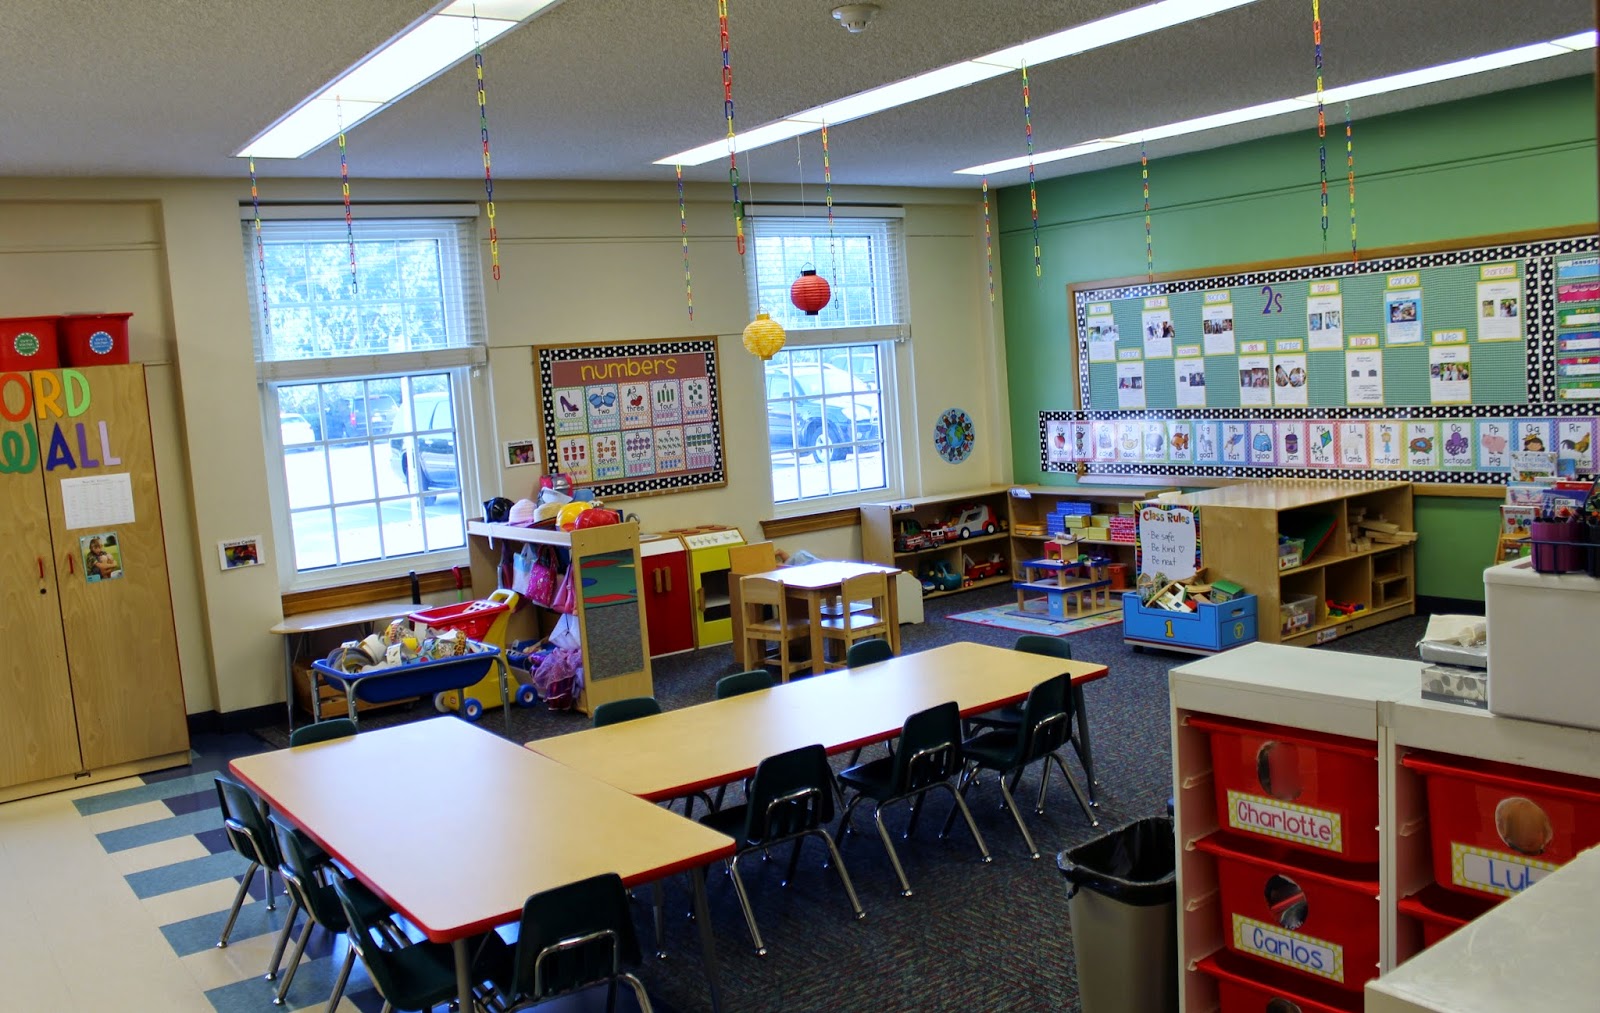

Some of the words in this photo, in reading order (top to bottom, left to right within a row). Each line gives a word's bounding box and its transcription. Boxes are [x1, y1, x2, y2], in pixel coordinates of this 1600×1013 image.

[1261, 285, 1283, 314] 2s
[580, 358, 677, 381] numbers
[600, 387, 604, 395] 2
[1201, 425, 1210, 434] Gg
[1287, 424, 1295, 434] Jj
[1380, 424, 1392, 432] Mm
[1415, 425, 1426, 433] Nn
[1450, 424, 1461, 432] Oo
[1489, 424, 1499, 435] Pp
[1569, 423, 1581, 432] Rr
[0, 420, 122, 474] WALL
[631, 450, 647, 460] eight
[1123, 450, 1136, 458] duck
[1199, 452, 1214, 460] goat
[1228, 452, 1240, 460] hat
[1255, 452, 1270, 462] igloo
[1286, 453, 1299, 463] jam
[1315, 454, 1329, 462] kite
[1345, 455, 1362, 463] lamb
[1375, 456, 1400, 464] mother
[1412, 457, 1430, 465] nest
[1443, 457, 1472, 465] octopus
[1489, 455, 1500, 466] pig
[1143, 510, 1165, 522] Class
[1167, 512, 1190, 525] Rules
[1150, 531, 1159, 540] Be
[1161, 531, 1175, 542] safe
[1151, 543, 1160, 552] Be
[1161, 542, 1176, 553] kind
[1151, 555, 1160, 565] Be
[1161, 556, 1176, 567] neat
[1165, 620, 1174, 637] 1
[1237, 801, 1331, 841] Charlotte
[1252, 926, 1324, 969] Carlos
